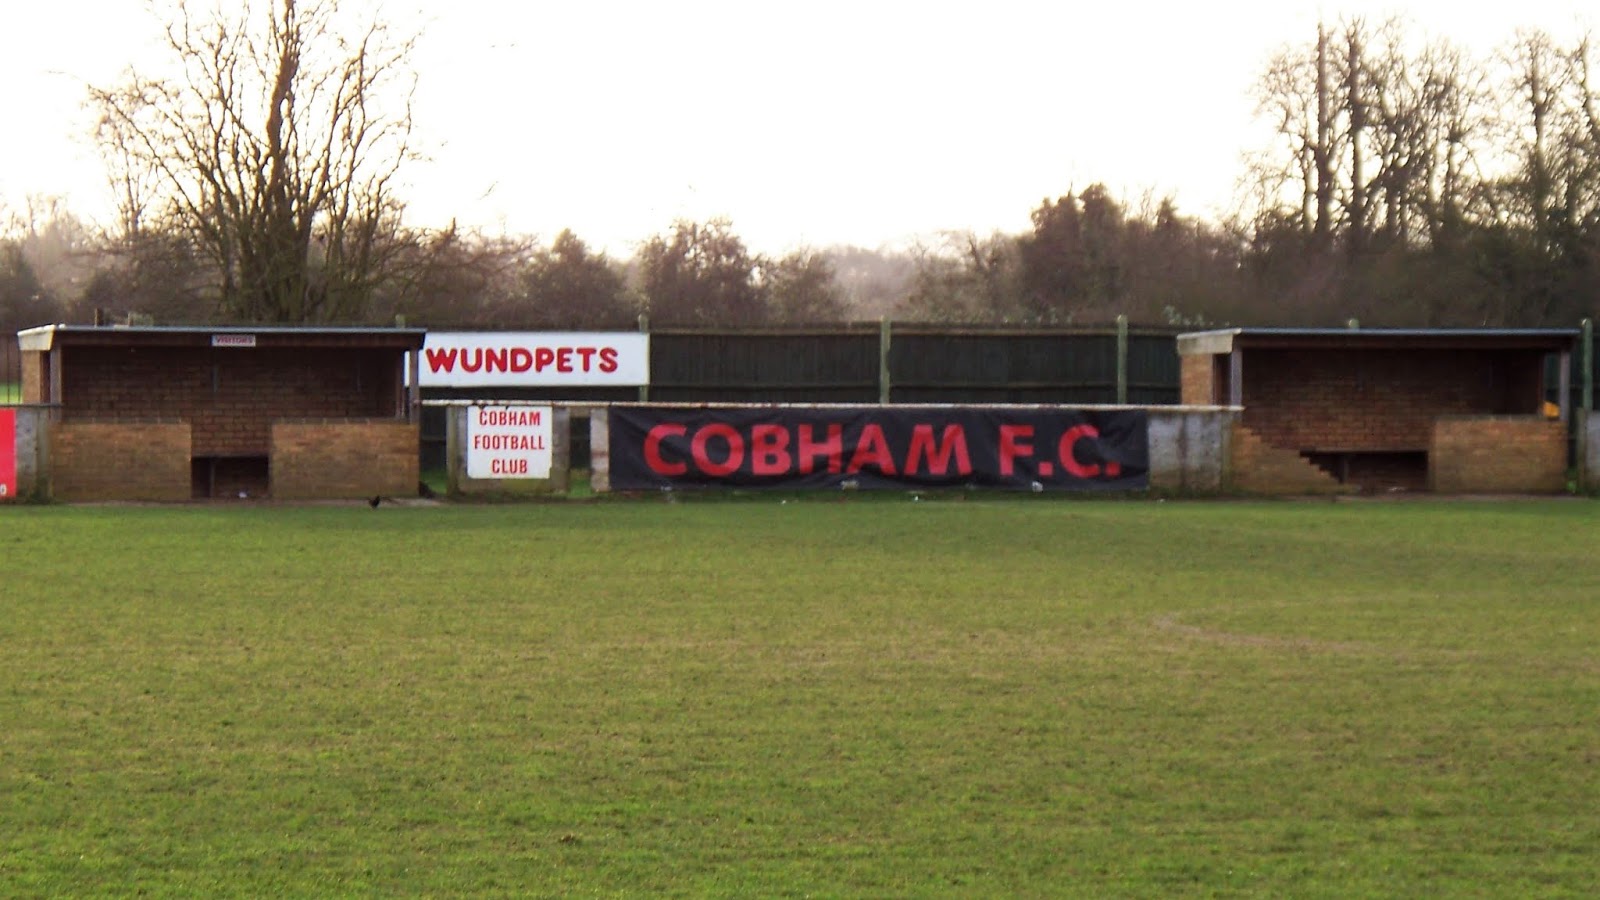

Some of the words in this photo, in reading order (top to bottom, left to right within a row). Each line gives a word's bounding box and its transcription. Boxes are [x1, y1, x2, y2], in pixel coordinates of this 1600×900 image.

[217, 334, 253, 345] VISITORS
[426, 346, 618, 374] WUNDPETS
[479, 410, 541, 426] COBHAM
[474, 434, 545, 450] FOOTBALL
[643, 423, 973, 477] COBHAM
[998, 423, 1121, 478] F.C.
[492, 459, 528, 475] CLUB
